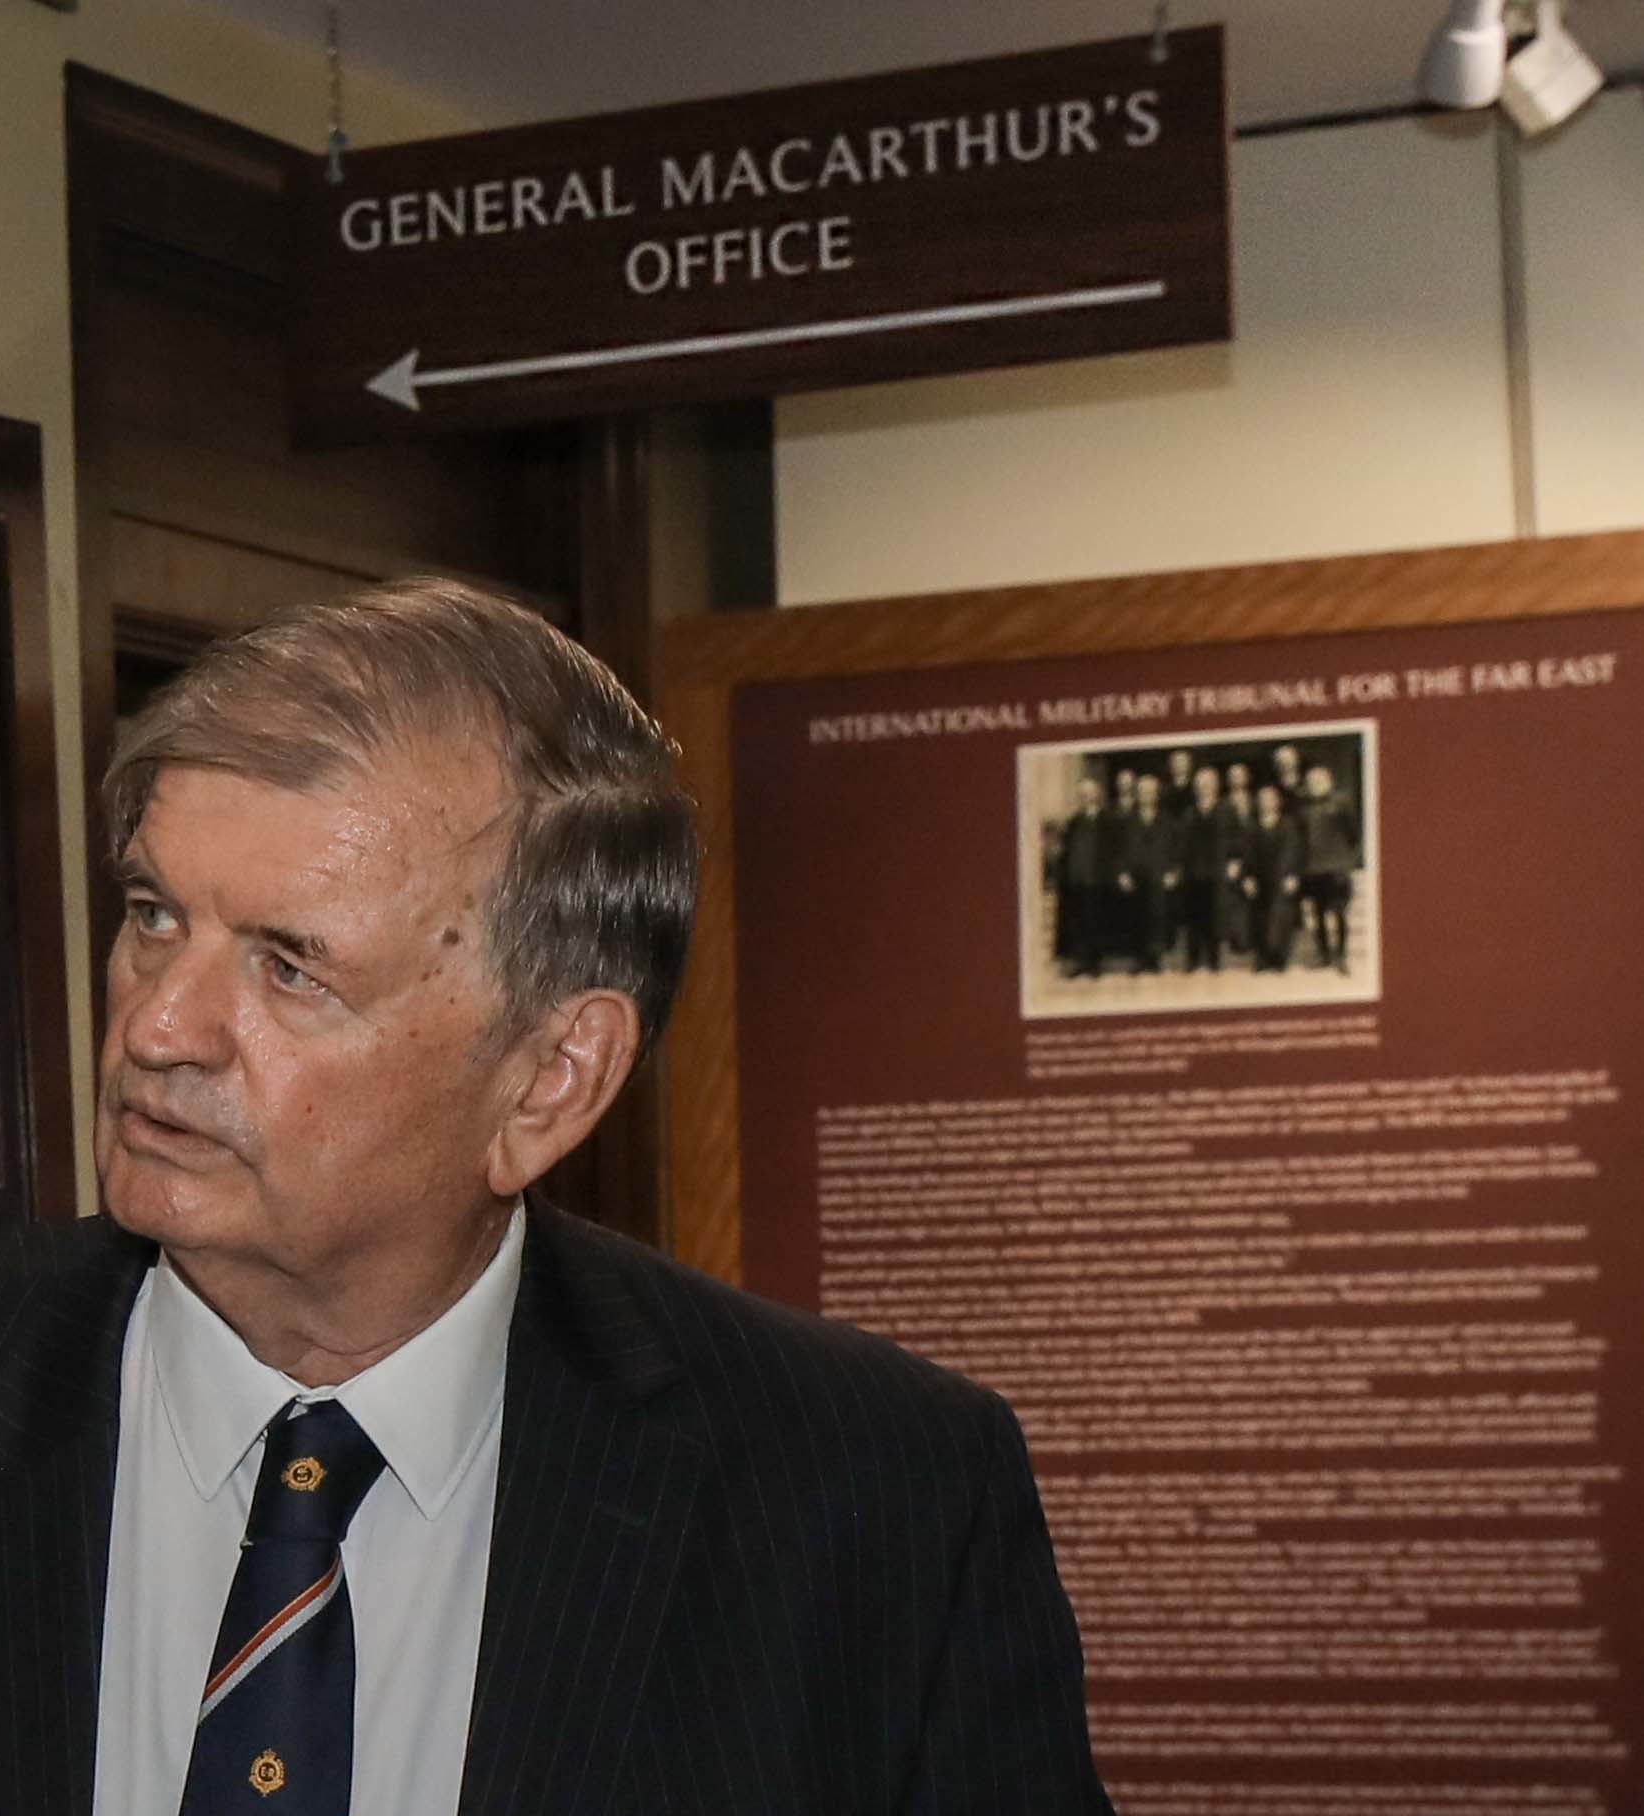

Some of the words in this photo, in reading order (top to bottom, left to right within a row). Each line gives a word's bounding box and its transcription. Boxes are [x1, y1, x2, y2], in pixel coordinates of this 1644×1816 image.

[341, 167, 634, 251] GENERAL
[662, 90, 1159, 209] MACARTHUR'S
[626, 216, 853, 294] OFFICE
[810, 704, 1028, 743] INTERNATIONAL
[1039, 691, 1170, 724] MILITARY
[1182, 679, 1327, 715] TRIBUNAL
[1338, 673, 1396, 702] FOR
[1407, 667, 1462, 697] THE
[1472, 661, 1531, 692] FAR
[1537, 653, 1615, 688] EAST
